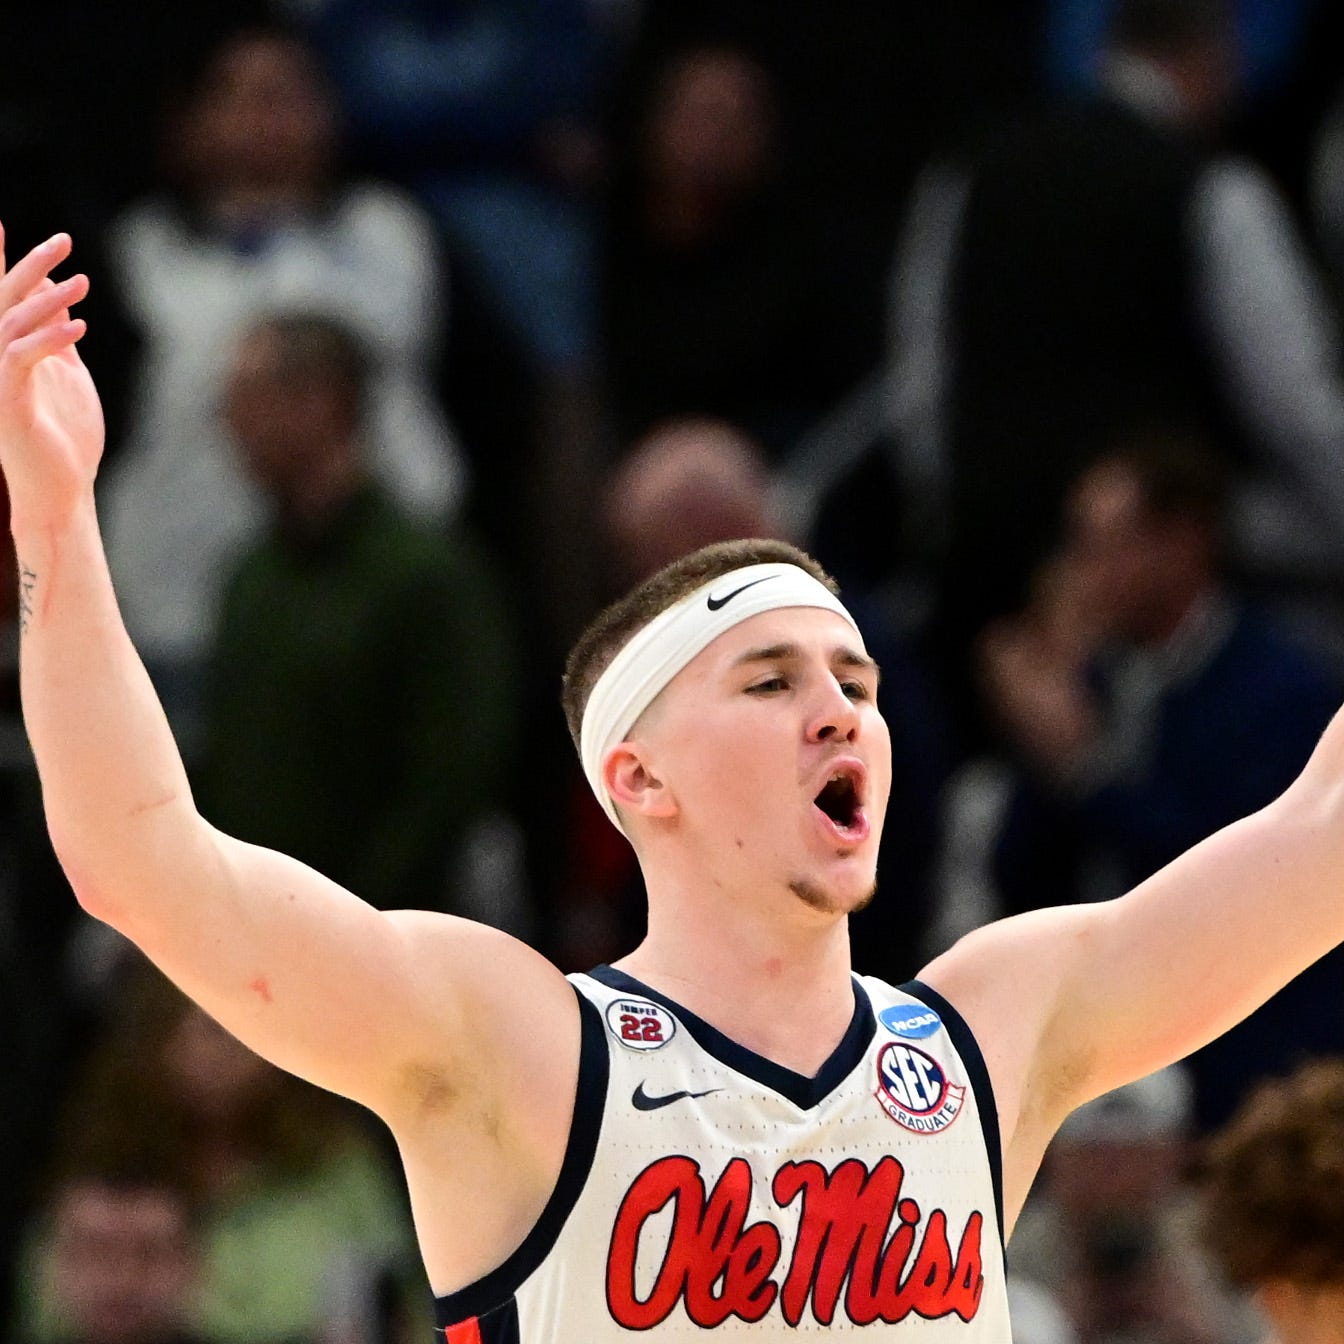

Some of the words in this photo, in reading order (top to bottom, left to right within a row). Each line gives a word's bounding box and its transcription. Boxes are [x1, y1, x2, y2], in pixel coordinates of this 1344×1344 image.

[619, 1014, 664, 1042] 22
[891, 1013, 940, 1032] NCAA
[881, 1045, 942, 1112] SEC
[888, 1101, 958, 1132] GRADUATE
[605, 1154, 782, 1331] Ole
[772, 1154, 985, 1329] Miss
